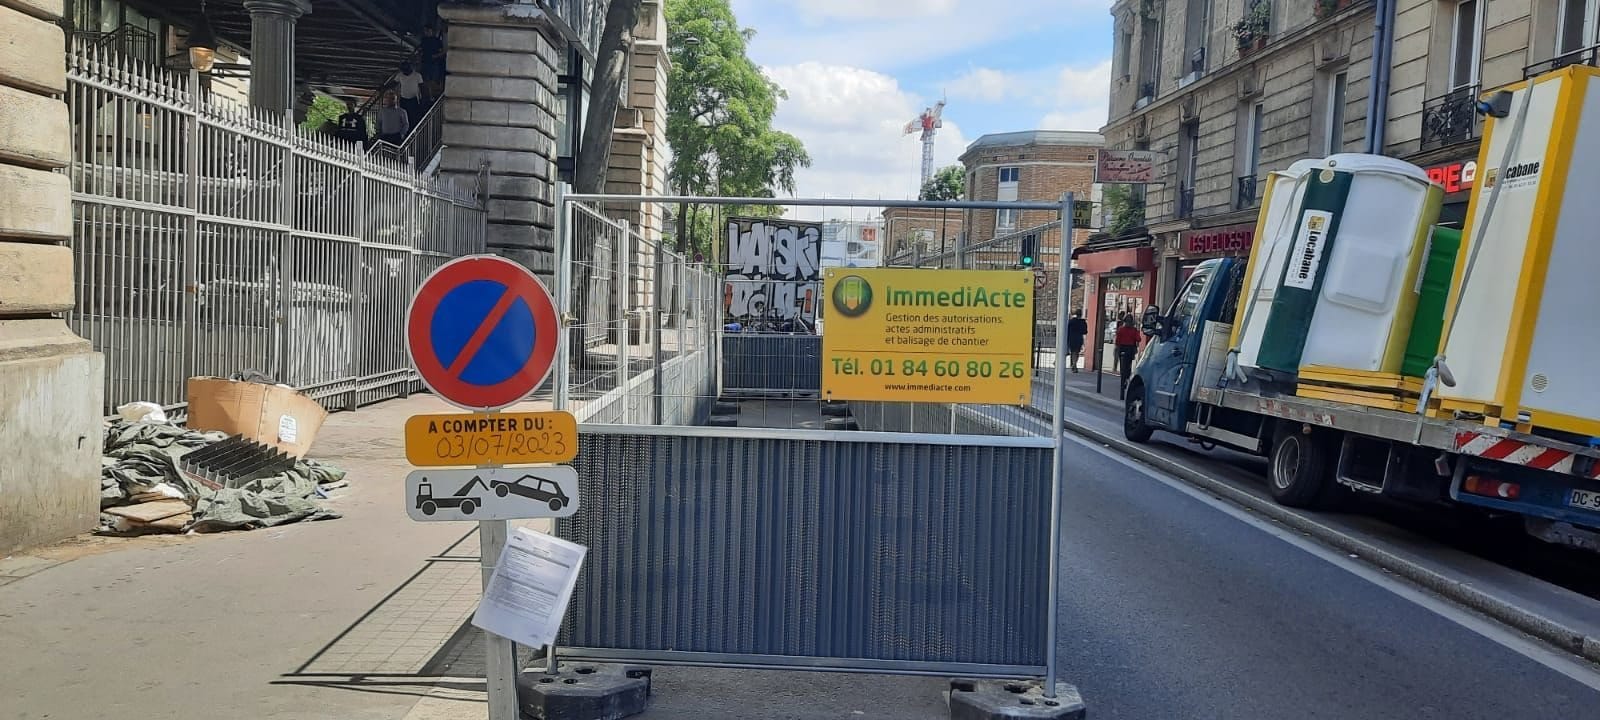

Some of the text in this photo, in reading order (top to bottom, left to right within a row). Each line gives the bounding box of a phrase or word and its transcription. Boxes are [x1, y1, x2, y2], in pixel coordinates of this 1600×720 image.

[1298, 230, 1322, 280] Locabane
[886, 286, 1026, 308] ImmediActe
[886, 312, 921, 323] Gestion
[923, 313, 940, 323] des
[885, 324, 976, 335] actes administratifs
[885, 335, 990, 347] et balisage de chantier
[832, 358, 1024, 379] Tél. 01 84 60 80 26
[885, 383, 971, 393] www.immediacte.com
[428, 421, 438, 434] A
[442, 418, 517, 434] COMPTER
[436, 431, 567, 459] 03/07/2023
